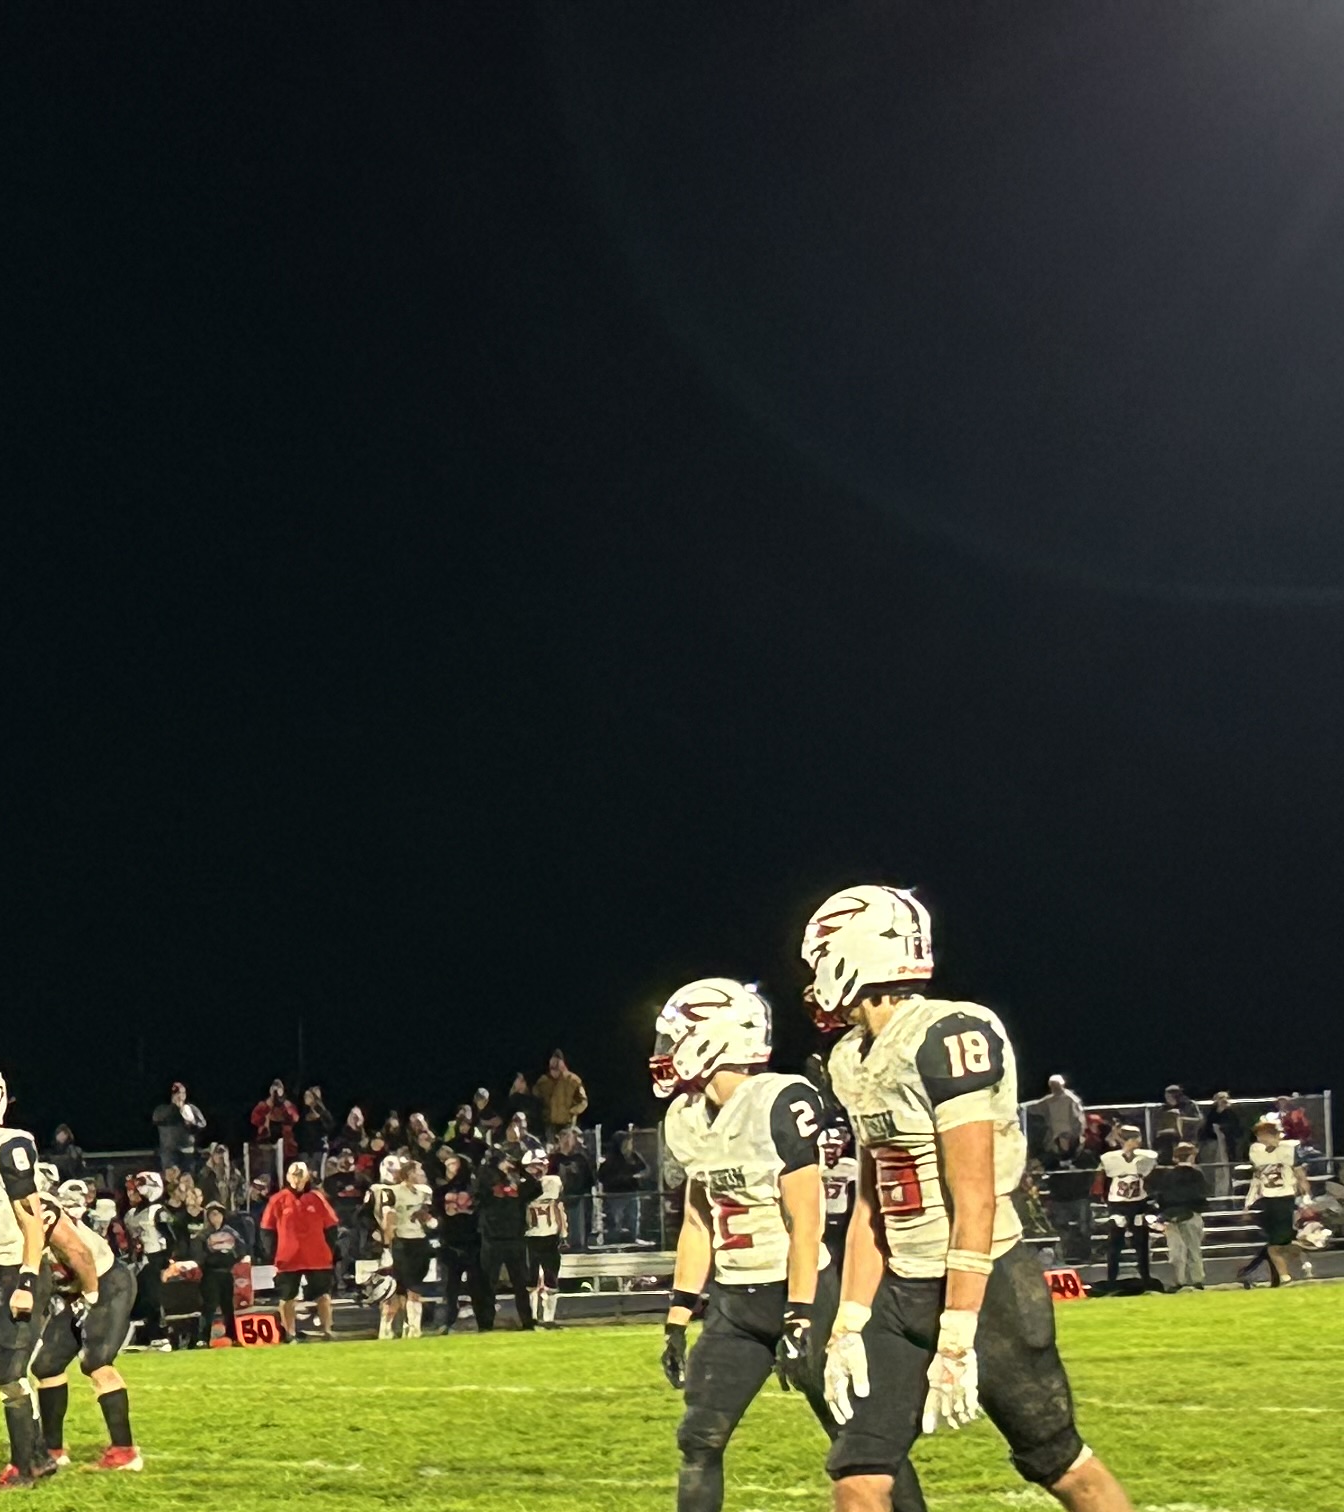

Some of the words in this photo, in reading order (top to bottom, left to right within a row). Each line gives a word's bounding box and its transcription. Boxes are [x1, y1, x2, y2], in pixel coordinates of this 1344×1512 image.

[943, 1031, 990, 1077] 18
[789, 1101, 818, 1137] 2
[241, 1318, 272, 1344] 50
